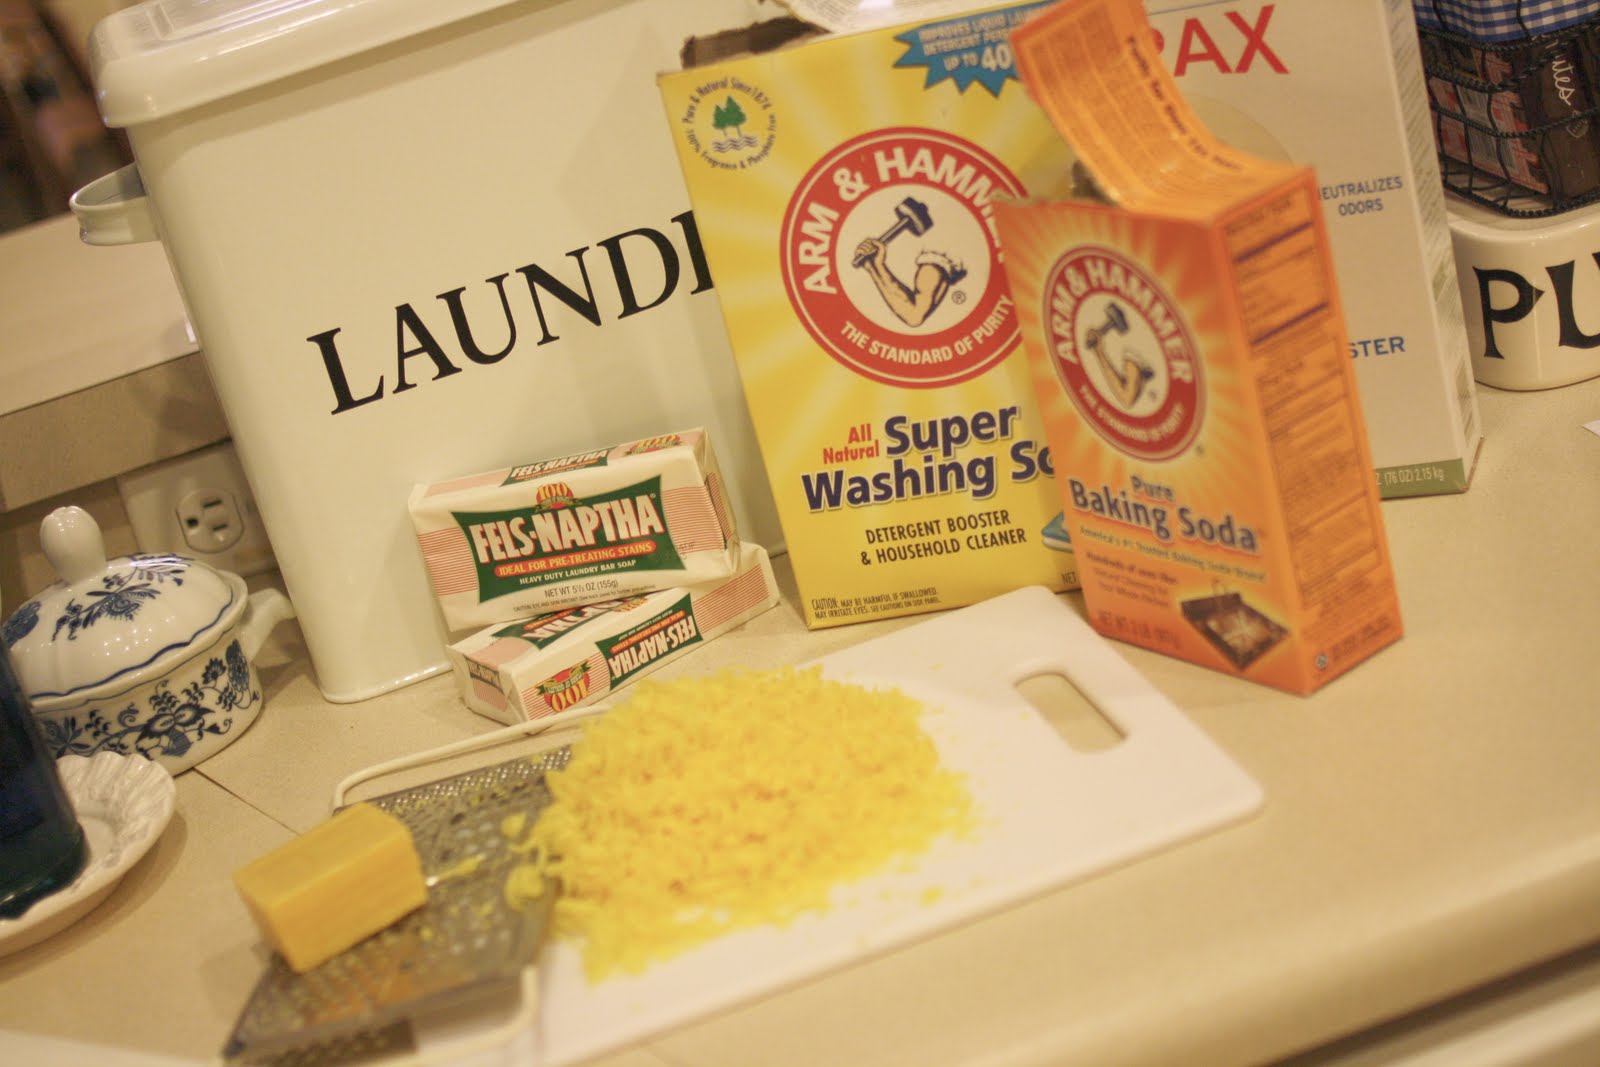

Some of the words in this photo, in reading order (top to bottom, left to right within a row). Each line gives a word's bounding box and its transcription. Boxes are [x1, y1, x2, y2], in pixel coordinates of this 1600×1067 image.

[1150, 4, 1289, 77] AX
[944, 56, 960, 71] UP
[962, 52, 978, 67] TO
[982, 42, 1012, 72] 40
[1318, 176, 1402, 200] EUTRALIZES
[1338, 198, 1383, 216] ODORS
[798, 202, 840, 295] ARM
[833, 167, 870, 202] &
[1064, 266, 1088, 296] &
[840, 321, 868, 348] THE
[868, 340, 952, 365] STANDARD
[954, 336, 974, 356] OF
[974, 294, 1014, 344] PURITY
[1052, 284, 1079, 365] ARM
[1084, 258, 1193, 384] HAMMER
[848, 424, 872, 444] All
[885, 406, 1017, 456] Super
[823, 440, 880, 464] Natural
[538, 482, 569, 500] 100
[802, 455, 996, 511] Washing
[1130, 474, 1174, 502] Pure
[1384, 471, 1397, 486] (76
[1432, 466, 1444, 481] kg
[866, 520, 941, 544] DETERGENT
[947, 510, 1010, 533] BOOSTER
[1069, 478, 1171, 540] Baking
[1178, 506, 1257, 552] Soda
[499, 565, 526, 576] IDEAL
[528, 561, 547, 571] FOR
[550, 550, 615, 568] PRE-TREATING
[618, 542, 652, 555] STAINS
[861, 552, 872, 566] &
[876, 538, 960, 564] HOUSEHOLD
[966, 528, 1026, 550] CLEANER
[520, 575, 542, 585] HEAVY
[544, 572, 563, 581] DUTY
[565, 566, 599, 578] LAUNDRY
[600, 563, 616, 571] BAR
[618, 560, 637, 569] SOAP
[1061, 571, 1076, 585] NET
[544, 589, 559, 598] NET
[560, 586, 570, 595] WT
[586, 582, 596, 591] OZ
[597, 579, 619, 590] (155g)
[841, 599, 853, 607] MAY
[855, 598, 862, 606] BE
[863, 594, 891, 604] HARMFUL
[892, 592, 898, 600] IF
[815, 610, 826, 619] MAY
[828, 608, 852, 618] IRRITATE
[552, 681, 588, 712] 100
